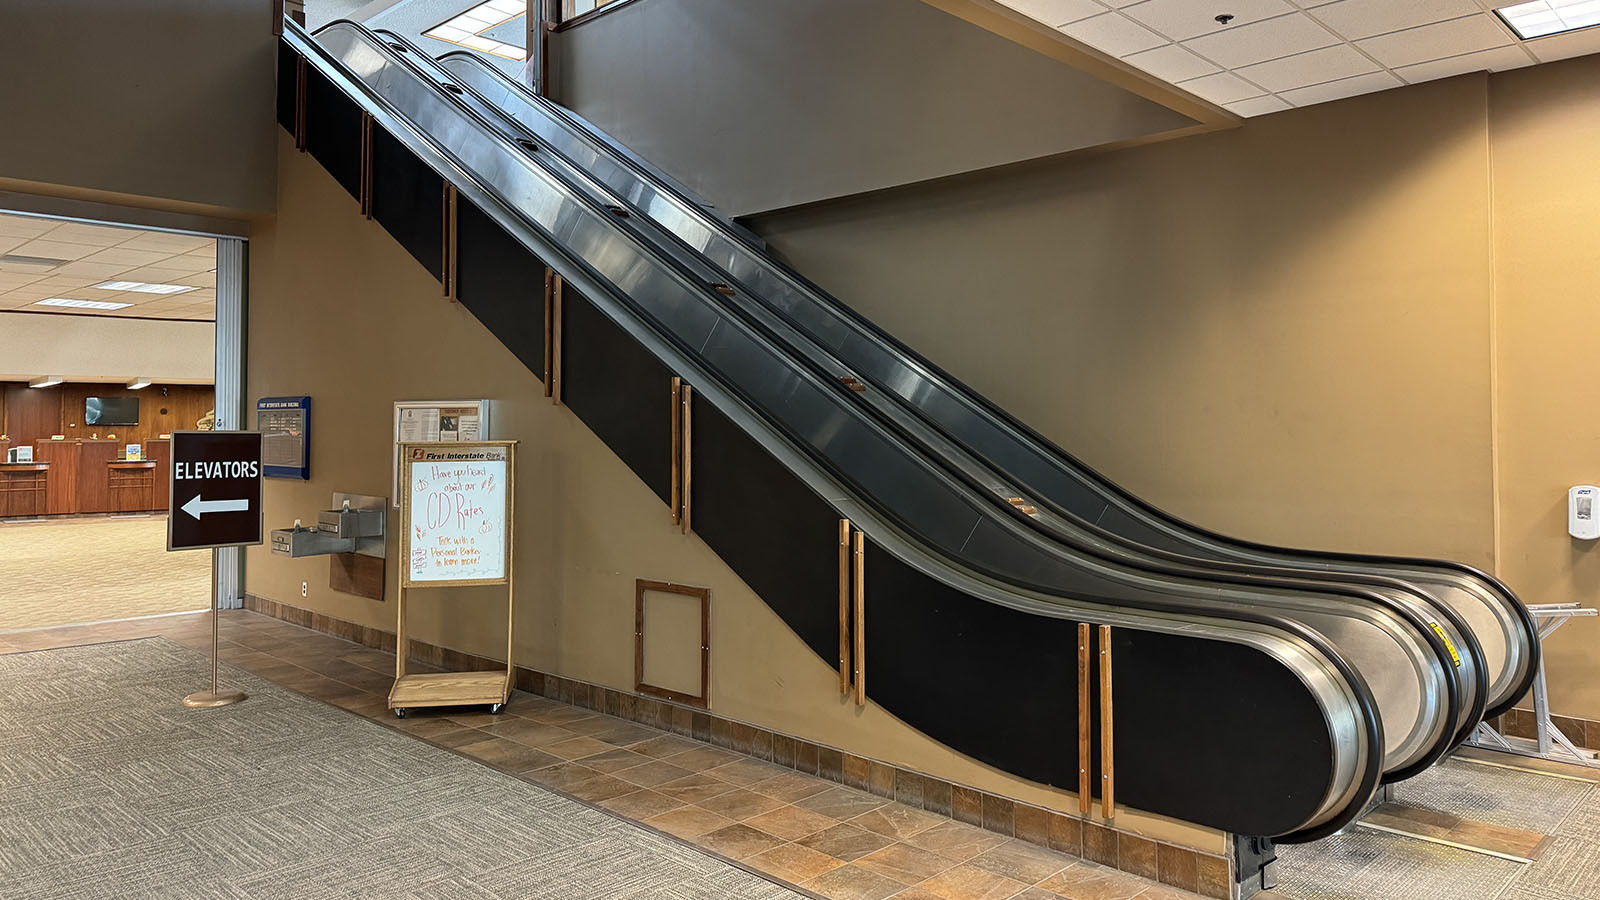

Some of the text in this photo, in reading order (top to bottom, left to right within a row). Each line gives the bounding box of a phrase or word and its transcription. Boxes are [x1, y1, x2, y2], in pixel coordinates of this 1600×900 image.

[176, 461, 258, 479] ELEVATORS
[432, 465, 486, 485] Have you heard
[444, 483, 462, 493] about
[427, 492, 484, 530] CD Rates
[437, 536, 451, 546] Talk
[453, 535, 468, 545] with
[430, 547, 457, 557] Personal
